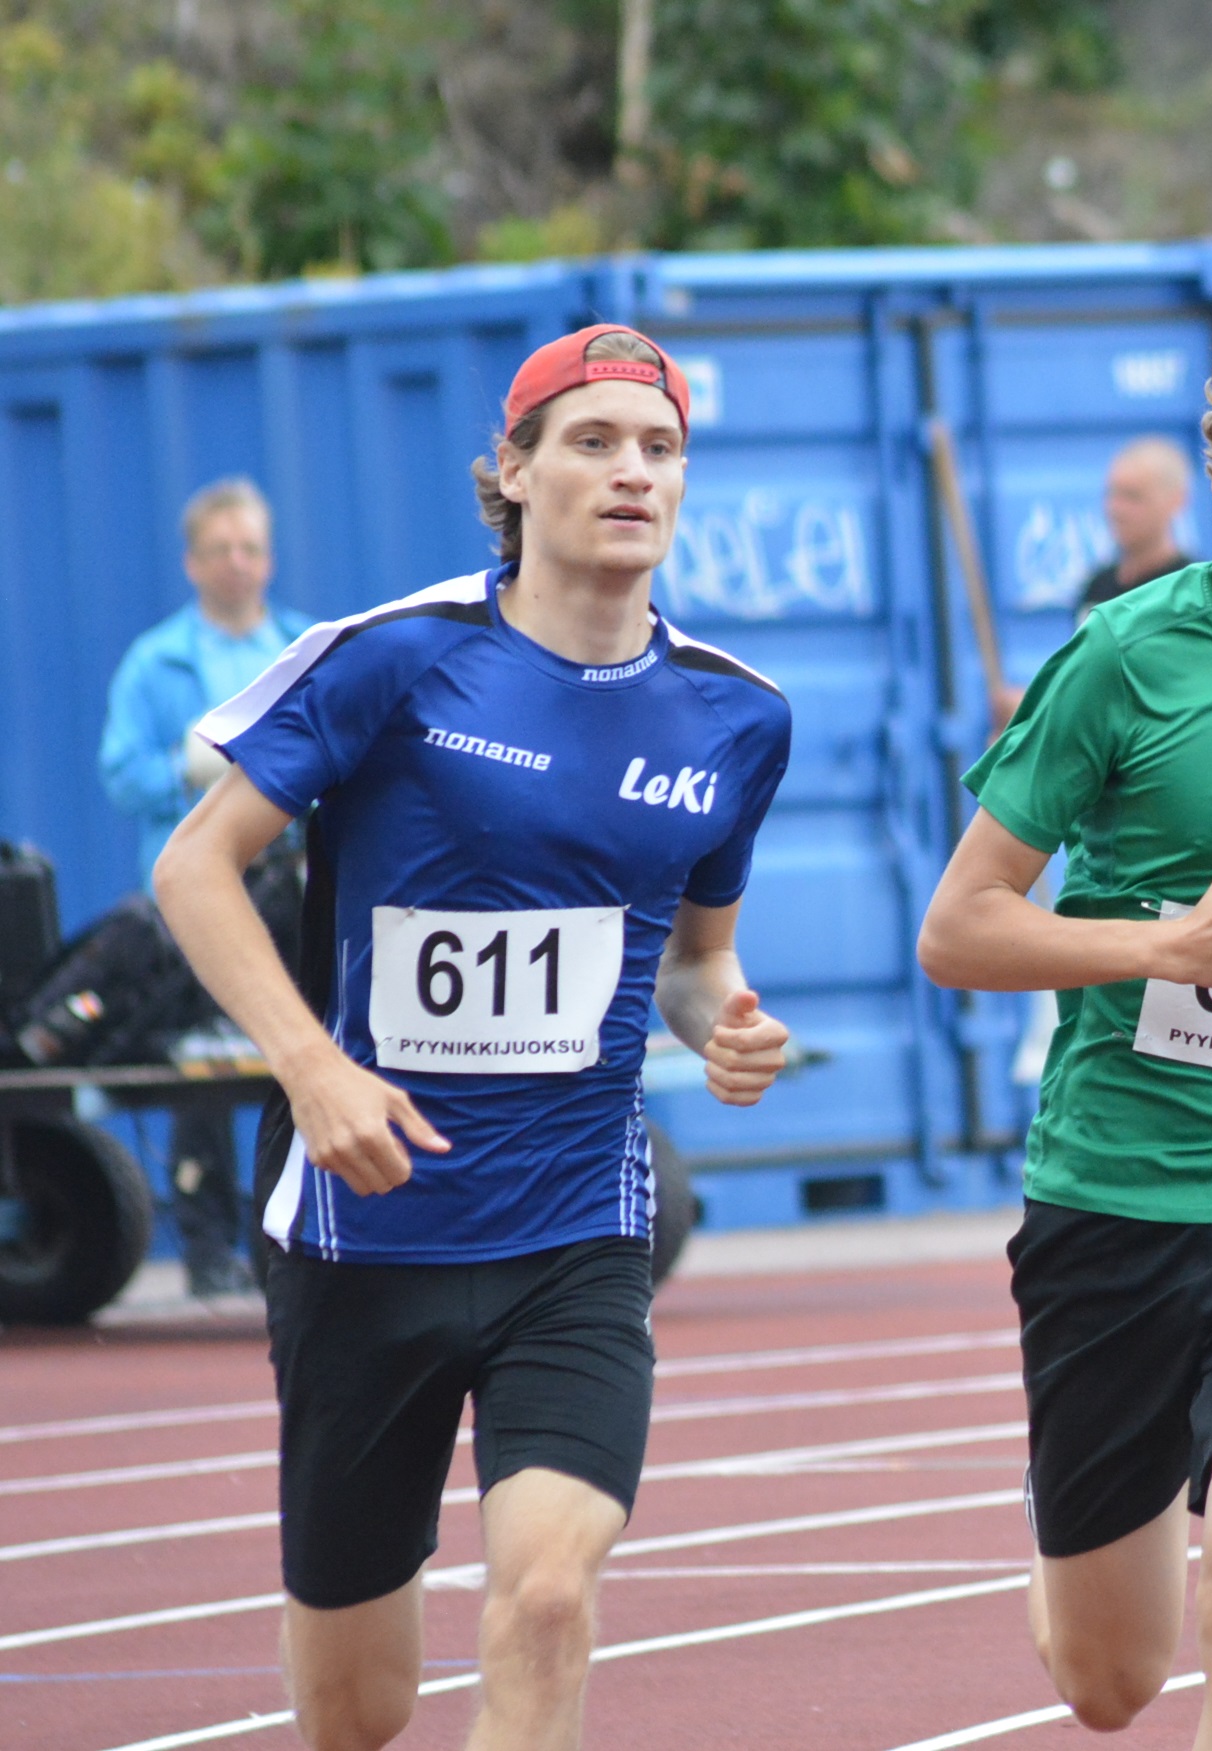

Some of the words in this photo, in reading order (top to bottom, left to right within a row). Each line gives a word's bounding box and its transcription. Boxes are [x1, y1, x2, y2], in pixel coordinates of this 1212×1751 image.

[581, 649, 658, 682] noname
[424, 726, 553, 772] noname
[618, 756, 718, 815] LeKi
[415, 927, 561, 1018] 611
[399, 1038, 586, 1056] PYYNIKKIJUOKSU
